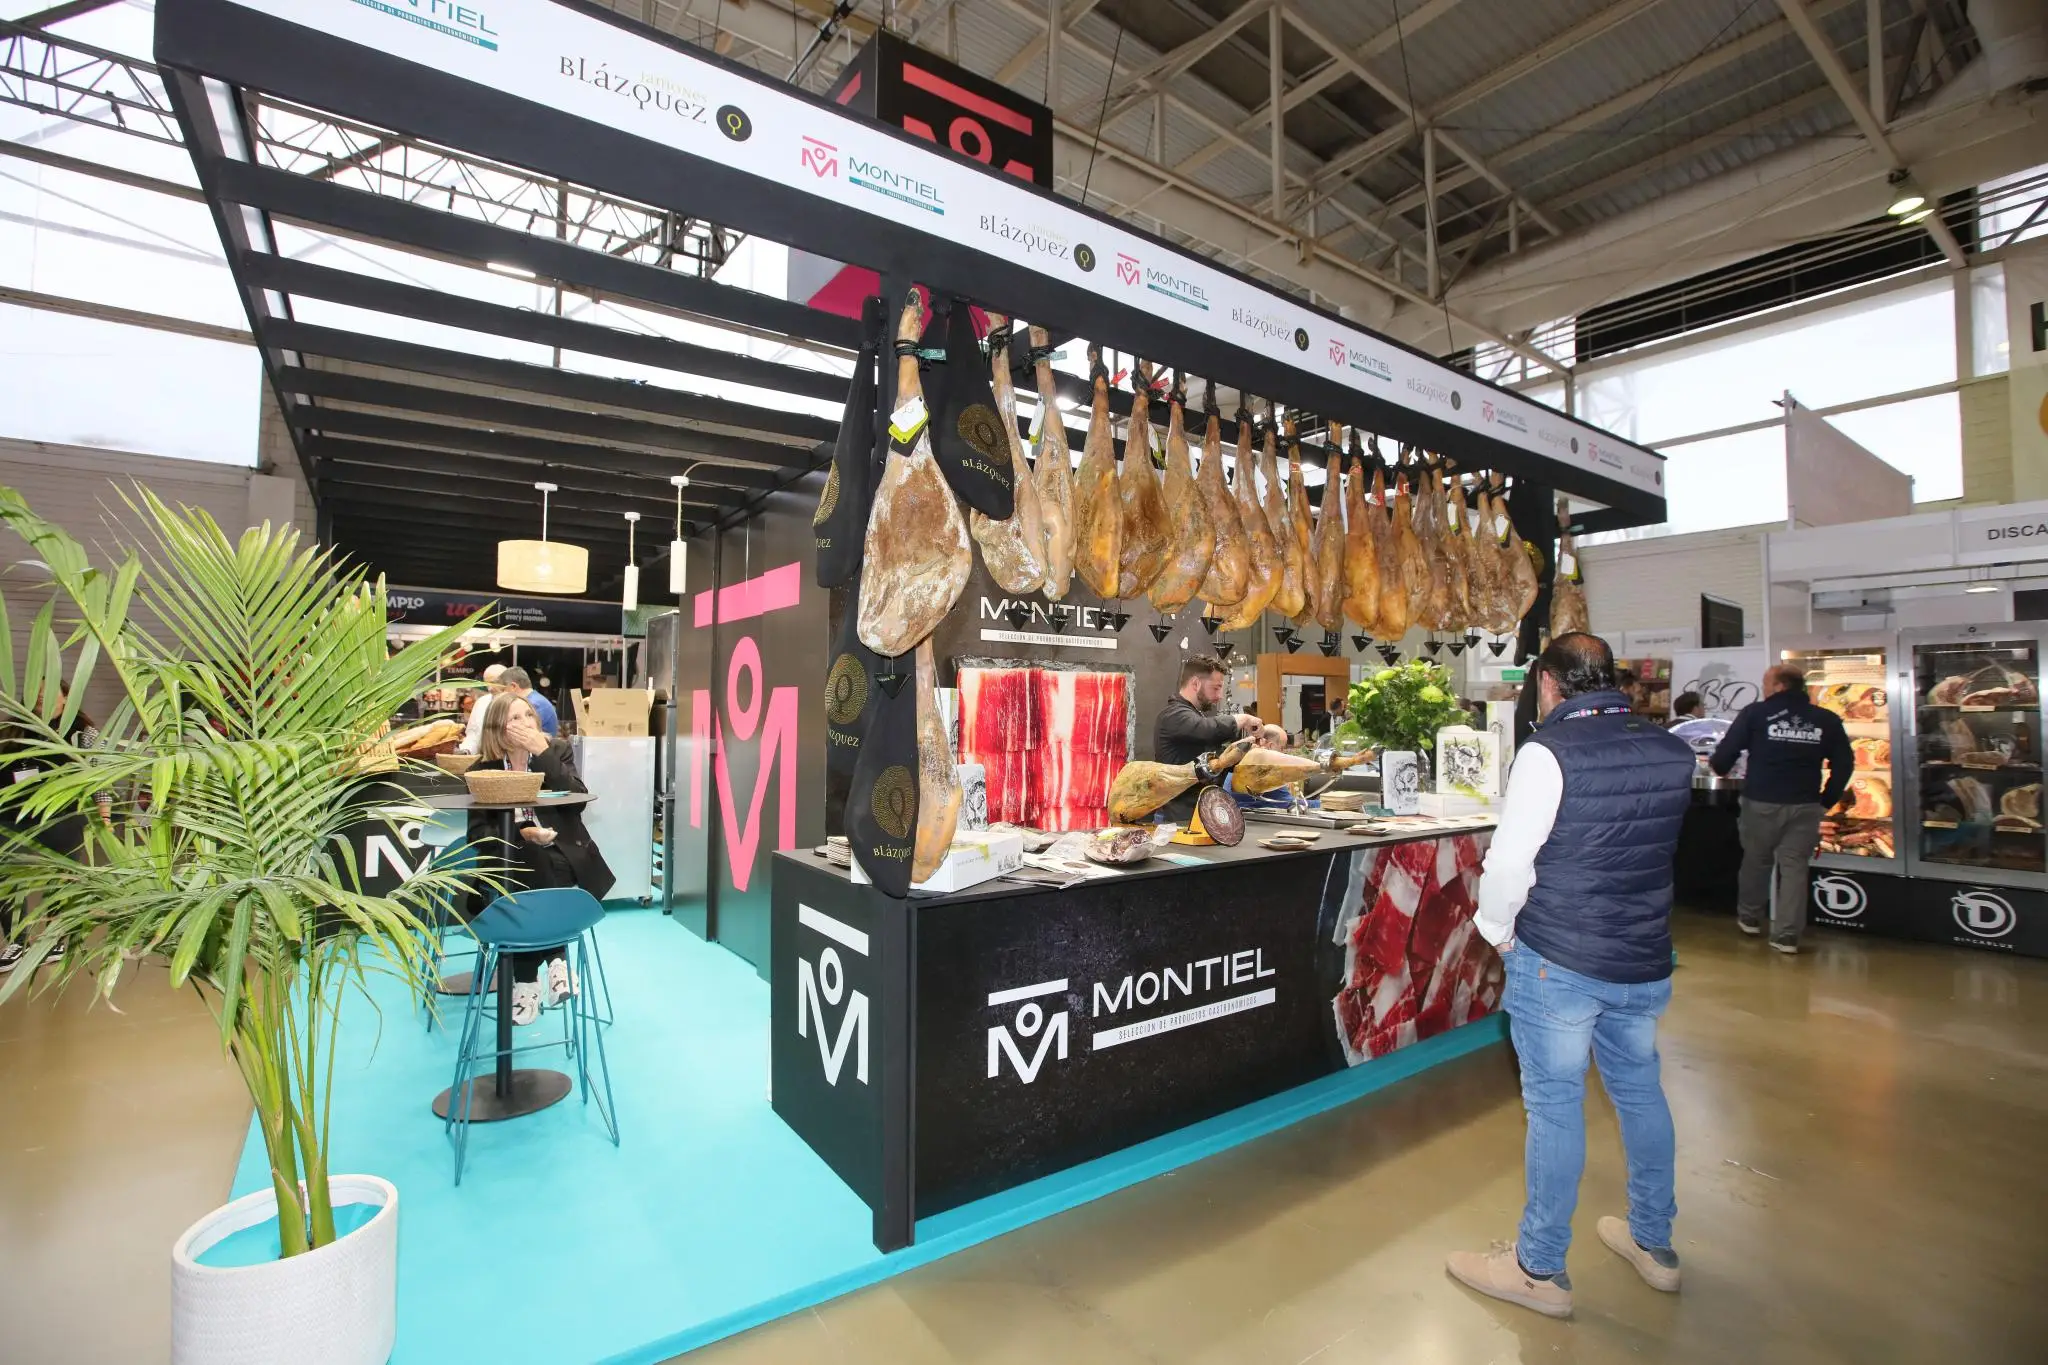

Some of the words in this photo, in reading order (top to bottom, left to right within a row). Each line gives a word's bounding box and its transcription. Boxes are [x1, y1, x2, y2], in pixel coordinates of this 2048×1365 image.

[408, 0, 498, 36] TIEL
[849, 156, 945, 204] MONTIEL
[1146, 267, 1209, 301] MONTIEL
[1349, 350, 1392, 375] MONTIEL
[980, 596, 1115, 630] MNTIE
[1092, 947, 1276, 1018] MONTIEL
[1159, 1019, 1167, 1030] DE
[1170, 1009, 1206, 1026] PRODUCTOS
